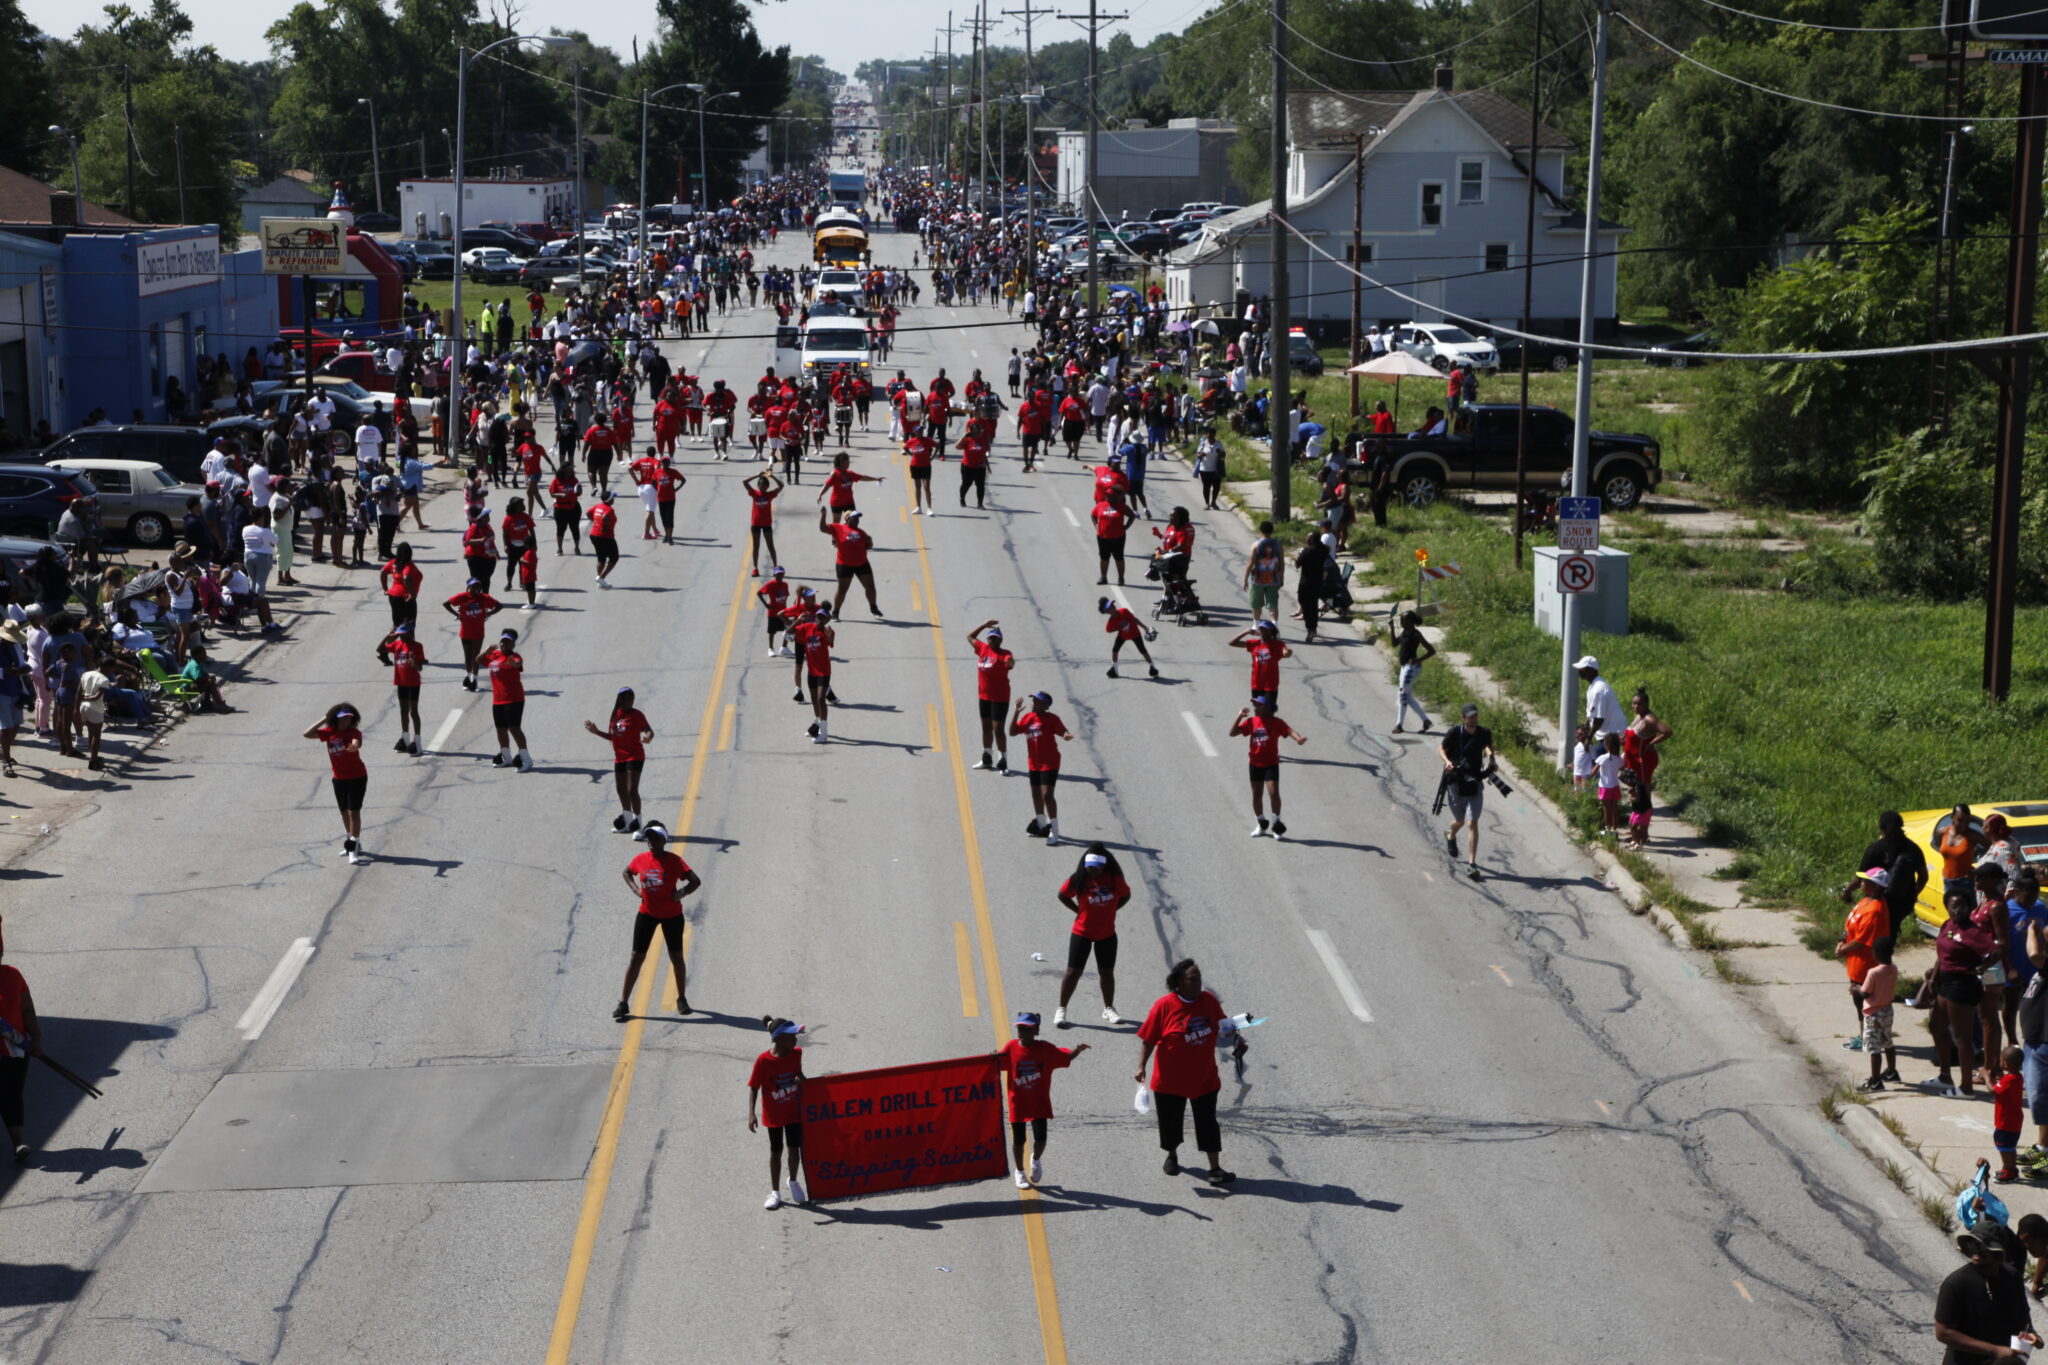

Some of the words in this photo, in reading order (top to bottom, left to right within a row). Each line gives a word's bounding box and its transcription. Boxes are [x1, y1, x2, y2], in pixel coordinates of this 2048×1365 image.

[303, 249, 321, 257] AUTO
[279, 256, 340, 265] REFINISHING
[1565, 526, 1593, 537] SNOW
[1562, 537, 1595, 548] ROUTE
[806, 1098, 873, 1123] SALEM
[880, 1090, 937, 1114] DRILL
[942, 1081, 997, 1105] TEAM
